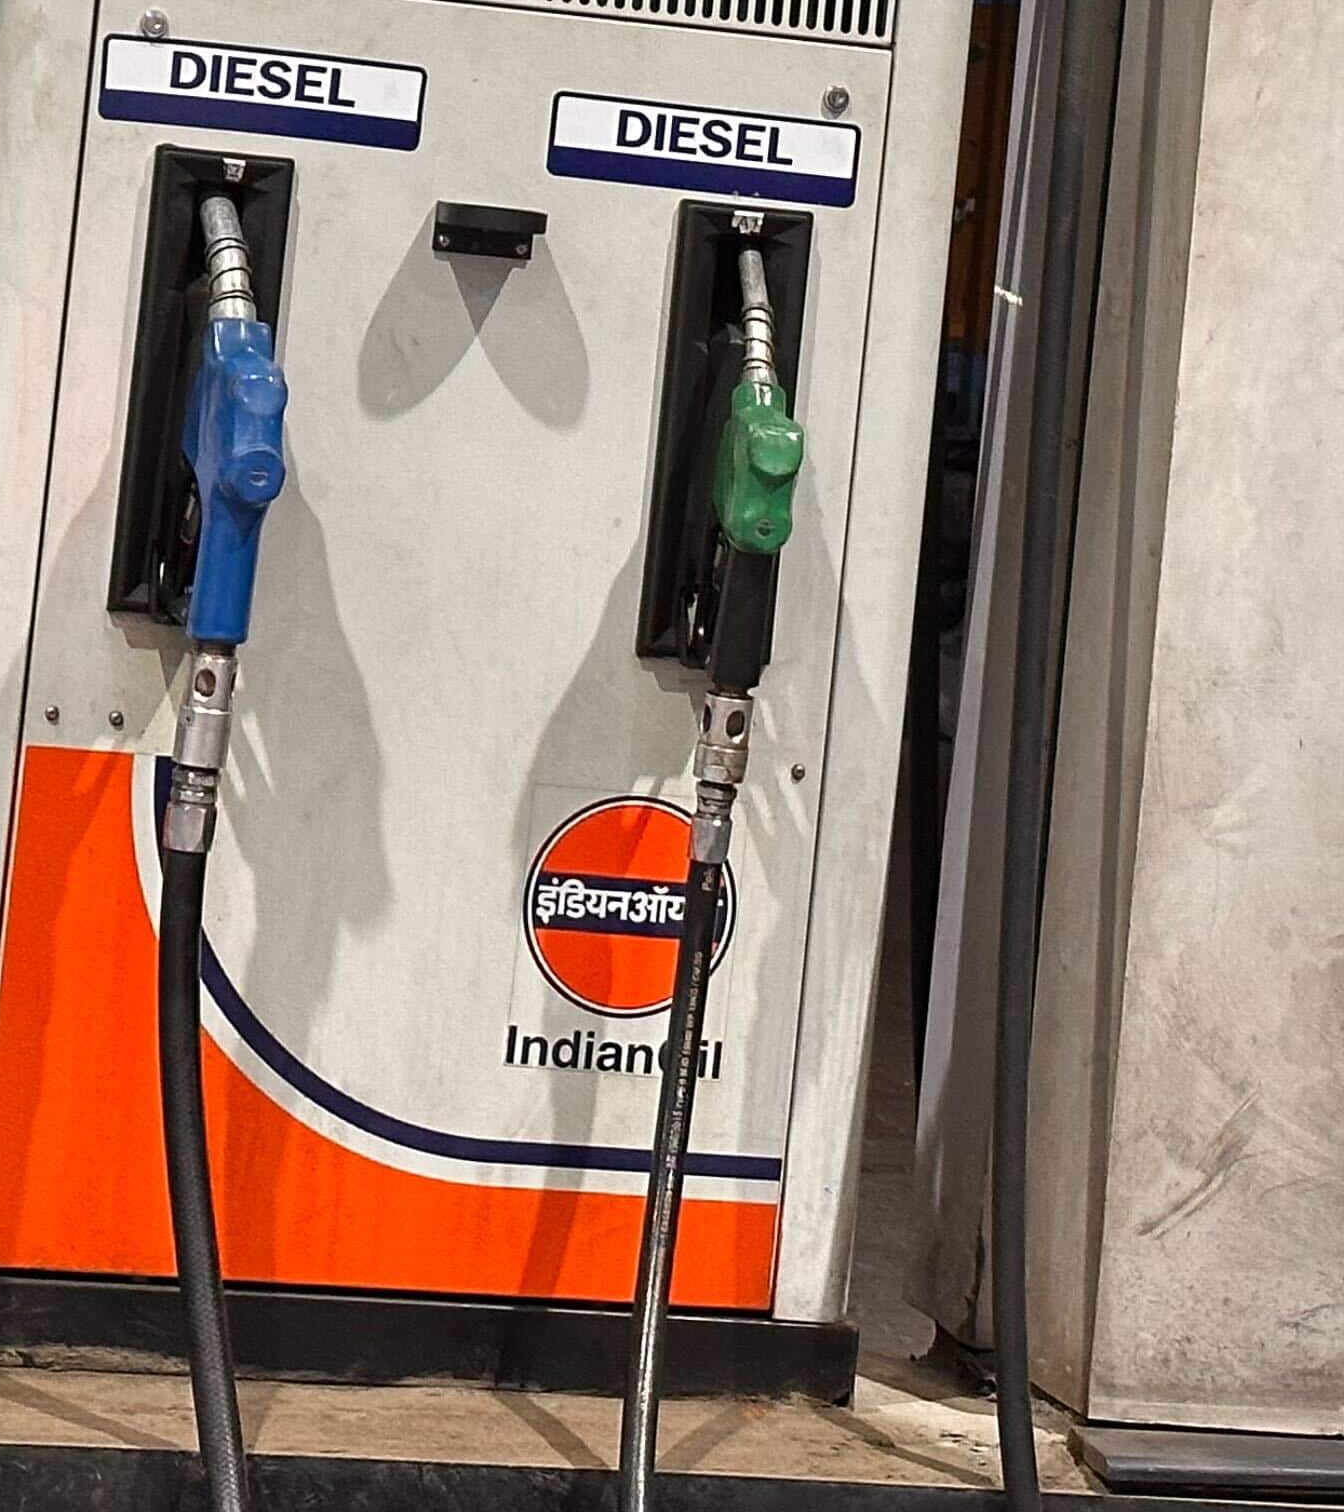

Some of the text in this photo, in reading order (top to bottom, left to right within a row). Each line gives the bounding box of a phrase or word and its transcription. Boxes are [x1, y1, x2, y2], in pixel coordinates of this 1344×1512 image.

[170, 51, 357, 108] DIESEL
[616, 109, 794, 166] DIESEL
[535, 877, 724, 925] इंडियनऑय
[506, 1025, 723, 1080] Indianil
